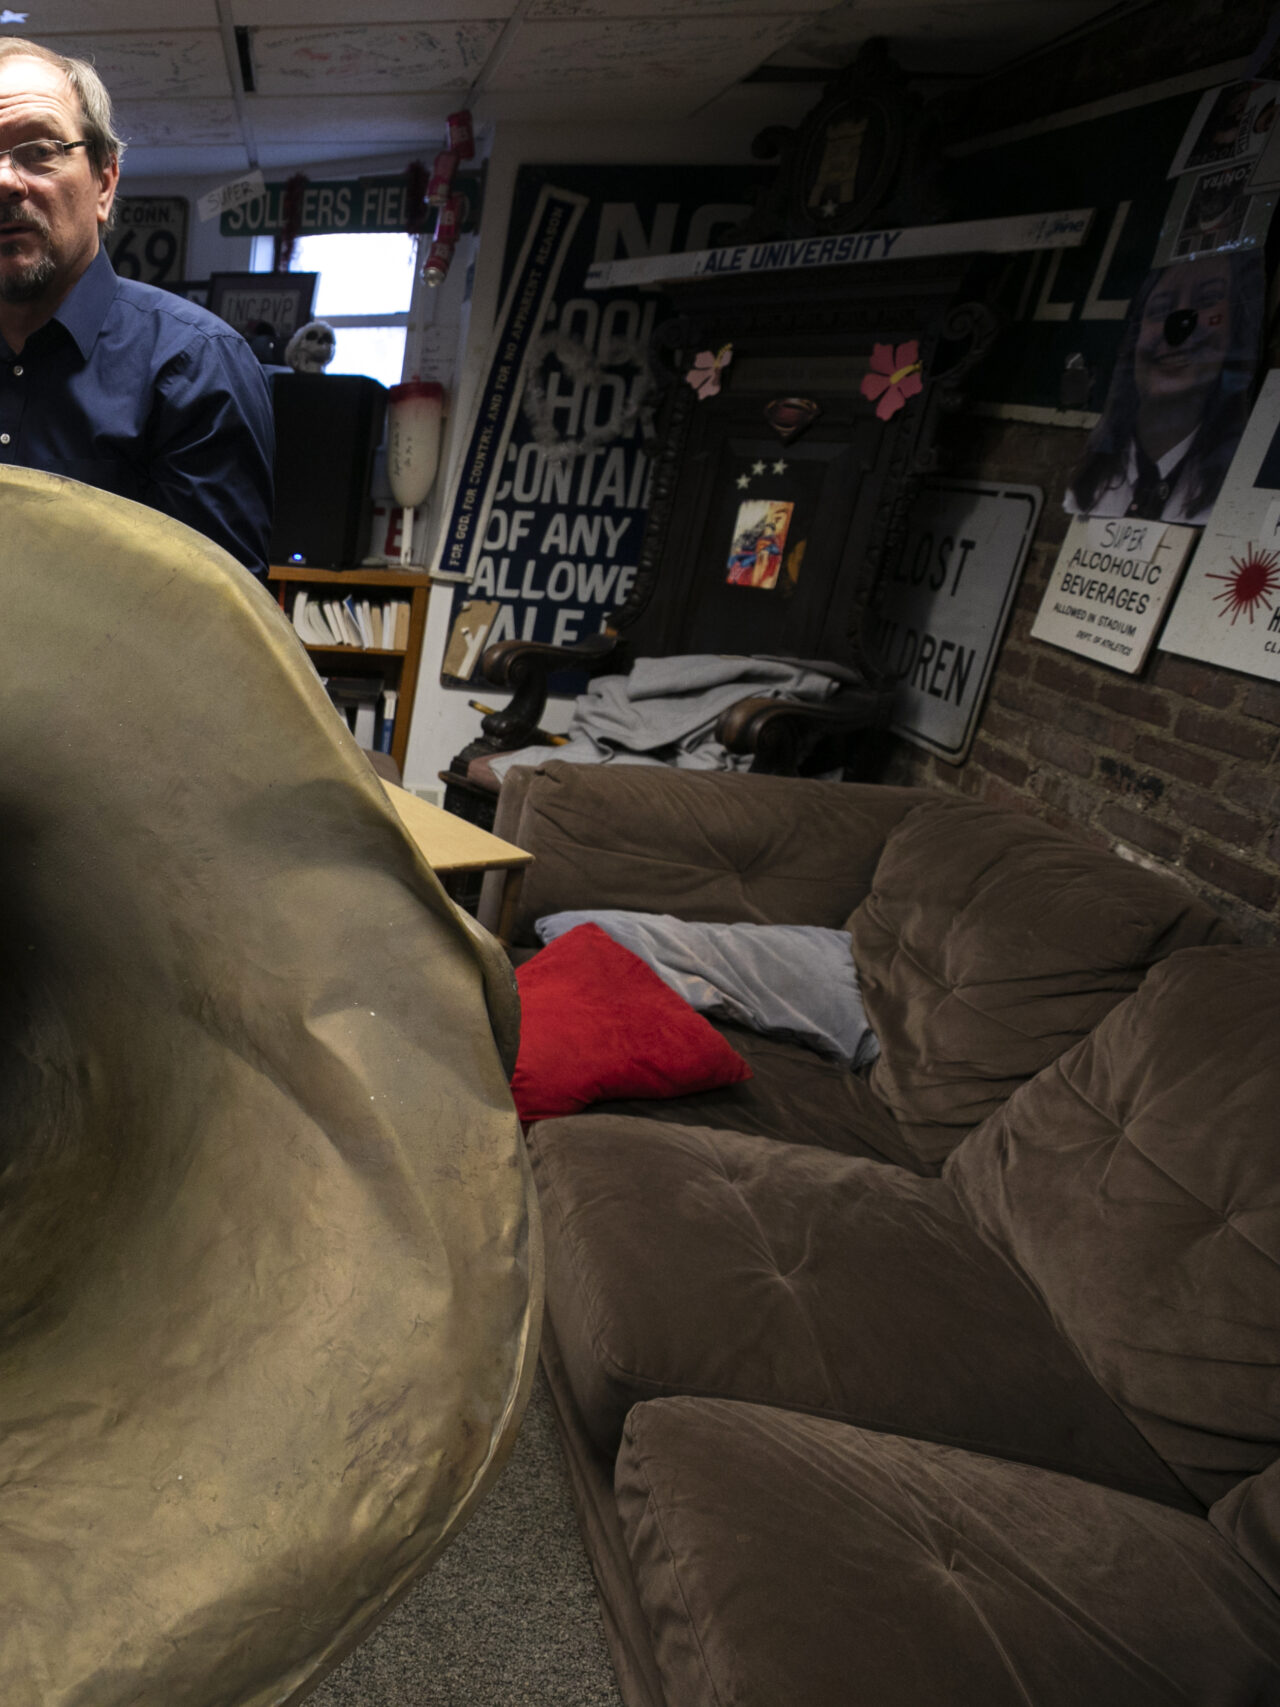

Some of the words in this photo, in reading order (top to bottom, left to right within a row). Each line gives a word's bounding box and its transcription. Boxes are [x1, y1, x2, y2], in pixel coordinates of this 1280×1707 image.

[121, 206, 175, 224] CONN.
[362, 186, 428, 217] FIEL
[112, 229, 177, 282] 69
[750, 231, 903, 269] UNIVERSITY
[503, 342, 517, 361] NO
[494, 364, 512, 391] FOR
[487, 393, 504, 421] AND
[462, 487, 478, 511] FOR
[482, 508, 536, 552] OF
[540, 512, 632, 559] ANY
[1100, 521, 1148, 552] SUPER
[449, 543, 464, 567] FOR
[1071, 548, 1162, 585] ALCOHOLIC
[1060, 573, 1150, 615] BEVERAGES
[1054, 602, 1087, 620] ALLOWED
[1088, 613, 1096, 623] IN
[1098, 616, 1137, 637] STADIUM
[1100, 637, 1133, 657] ATHLETICS
